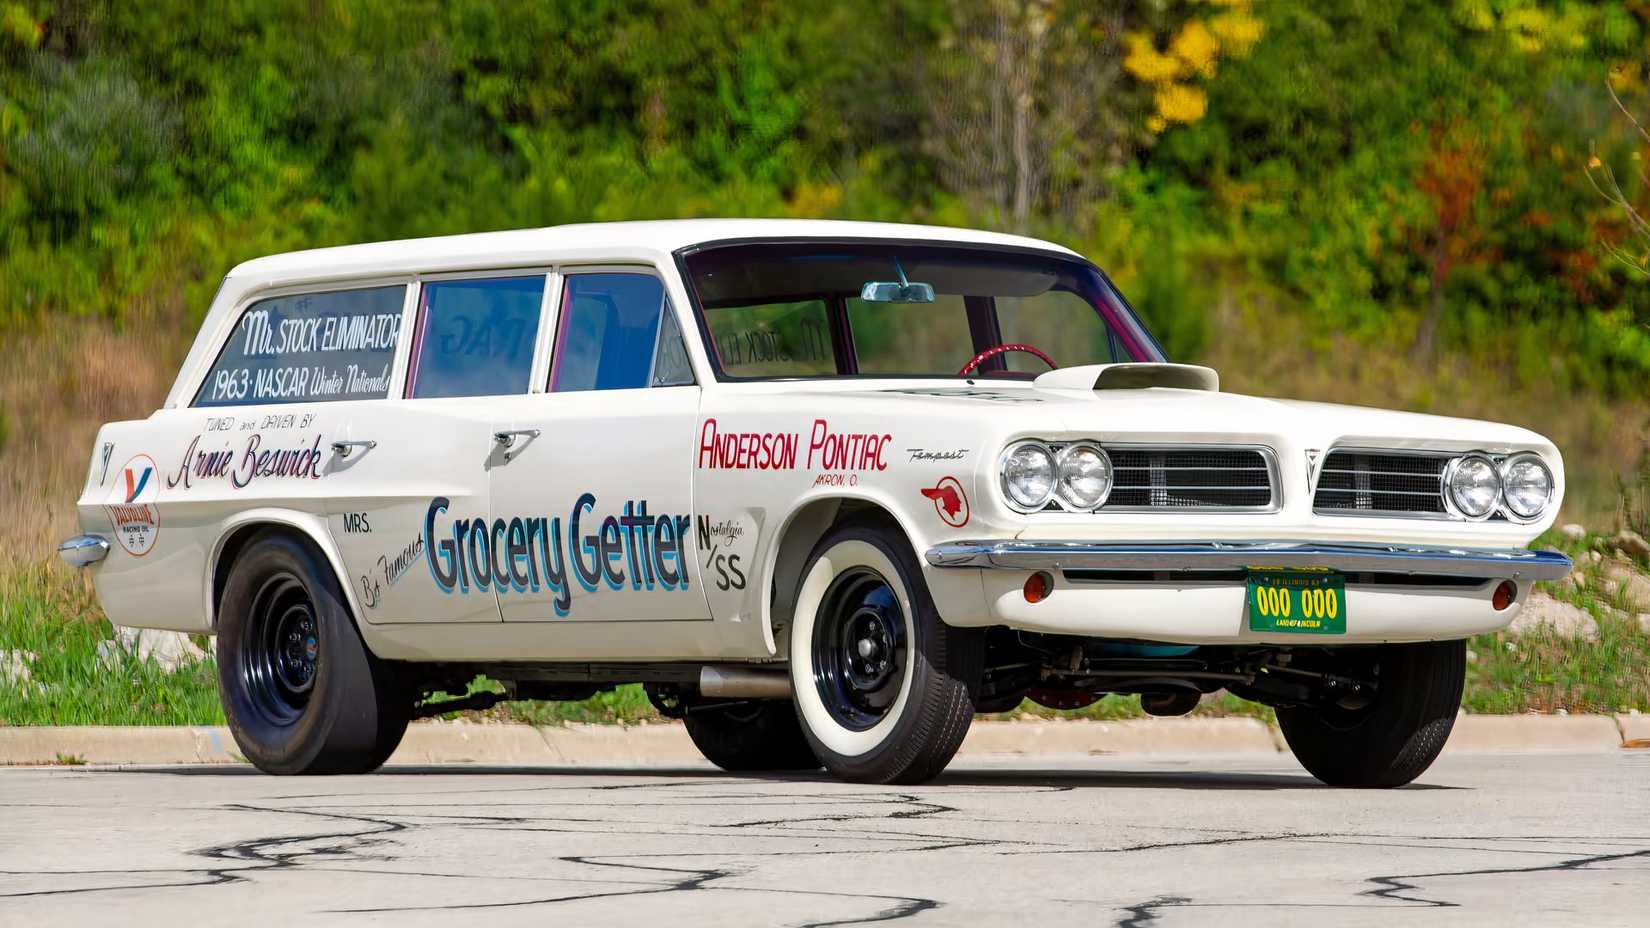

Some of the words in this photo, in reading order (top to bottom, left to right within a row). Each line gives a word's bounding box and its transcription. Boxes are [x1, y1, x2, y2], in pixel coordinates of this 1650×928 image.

[242, 310, 275, 356] Mr.
[276, 317, 322, 354] STOCK
[321, 314, 401, 351] ELIMINATOR
[253, 367, 310, 399] NASCAR
[310, 366, 343, 396] Winter
[345, 362, 390, 394] Nationals
[207, 417, 235, 432] TUNED
[260, 414, 296, 430] DRIVEN
[300, 413, 316, 428] BY
[167, 434, 233, 489] Arnie
[231, 433, 323, 489] Beswick
[699, 418, 799, 470] ANDERSON
[807, 419, 892, 472] PONTIAC
[906, 448, 970, 463] Tempest
[110, 504, 154, 526] VALVOLINE
[343, 512, 373, 533] MRS.
[697, 514, 744, 550] Nostalgia
[376, 531, 424, 586] Famous
[424, 496, 571, 617] Grocery
[570, 492, 691, 592] Getter
[1257, 586, 1291, 618] 000
[1302, 588, 1338, 619] 000
